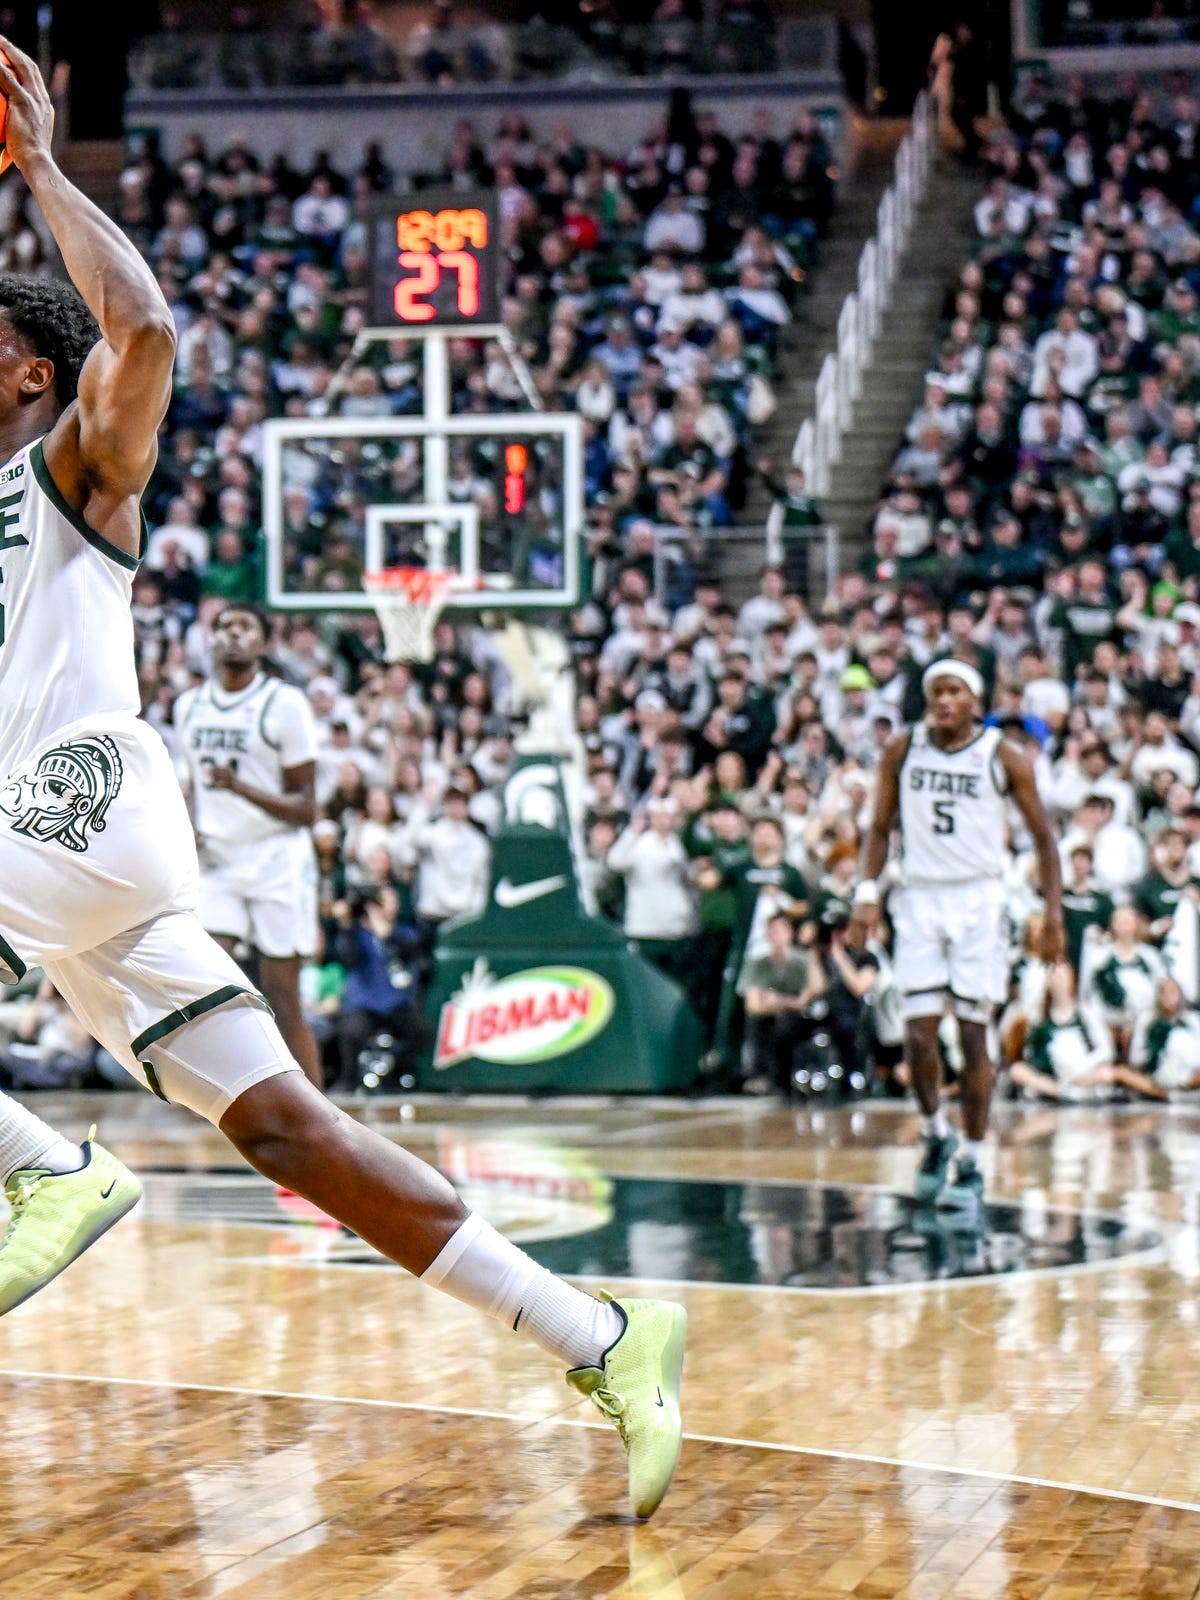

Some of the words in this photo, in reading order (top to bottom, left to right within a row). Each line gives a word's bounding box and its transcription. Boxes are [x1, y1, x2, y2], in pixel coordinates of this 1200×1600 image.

[394, 251, 479, 322] 27
[191, 727, 249, 753] STATE
[910, 767, 980, 799] STATE
[932, 800, 955, 834] 5
[437, 984, 593, 1059] LIBMAN
